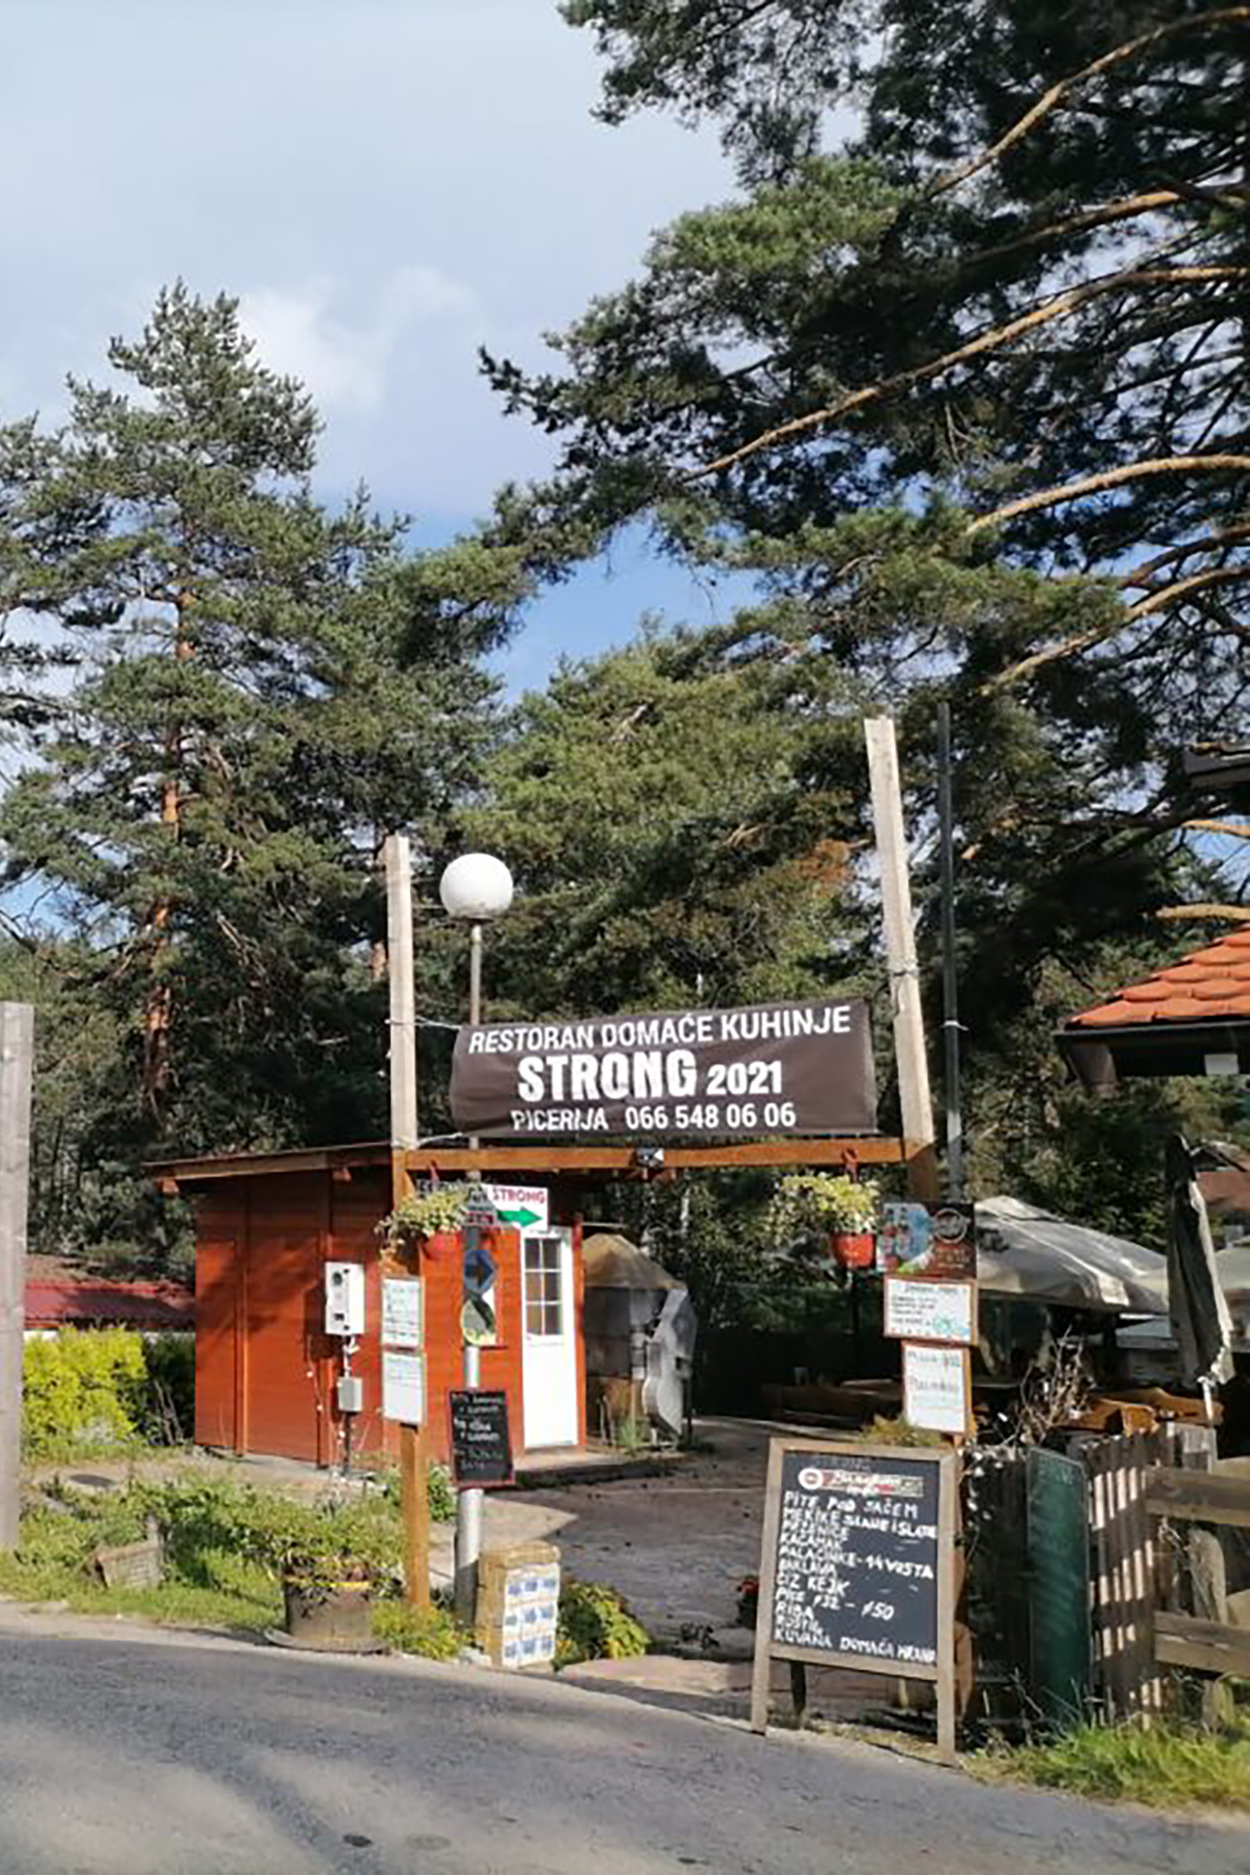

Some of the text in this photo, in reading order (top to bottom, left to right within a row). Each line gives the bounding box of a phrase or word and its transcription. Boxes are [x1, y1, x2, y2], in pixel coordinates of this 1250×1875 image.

[468, 1005, 852, 1054] RESTORAN DOMAĆE KUHINJE
[518, 1049, 783, 1102] STRONG 2021
[510, 1102, 796, 1132] PICERIJA 066 548 06 06
[492, 1187, 547, 1205] STRONG
